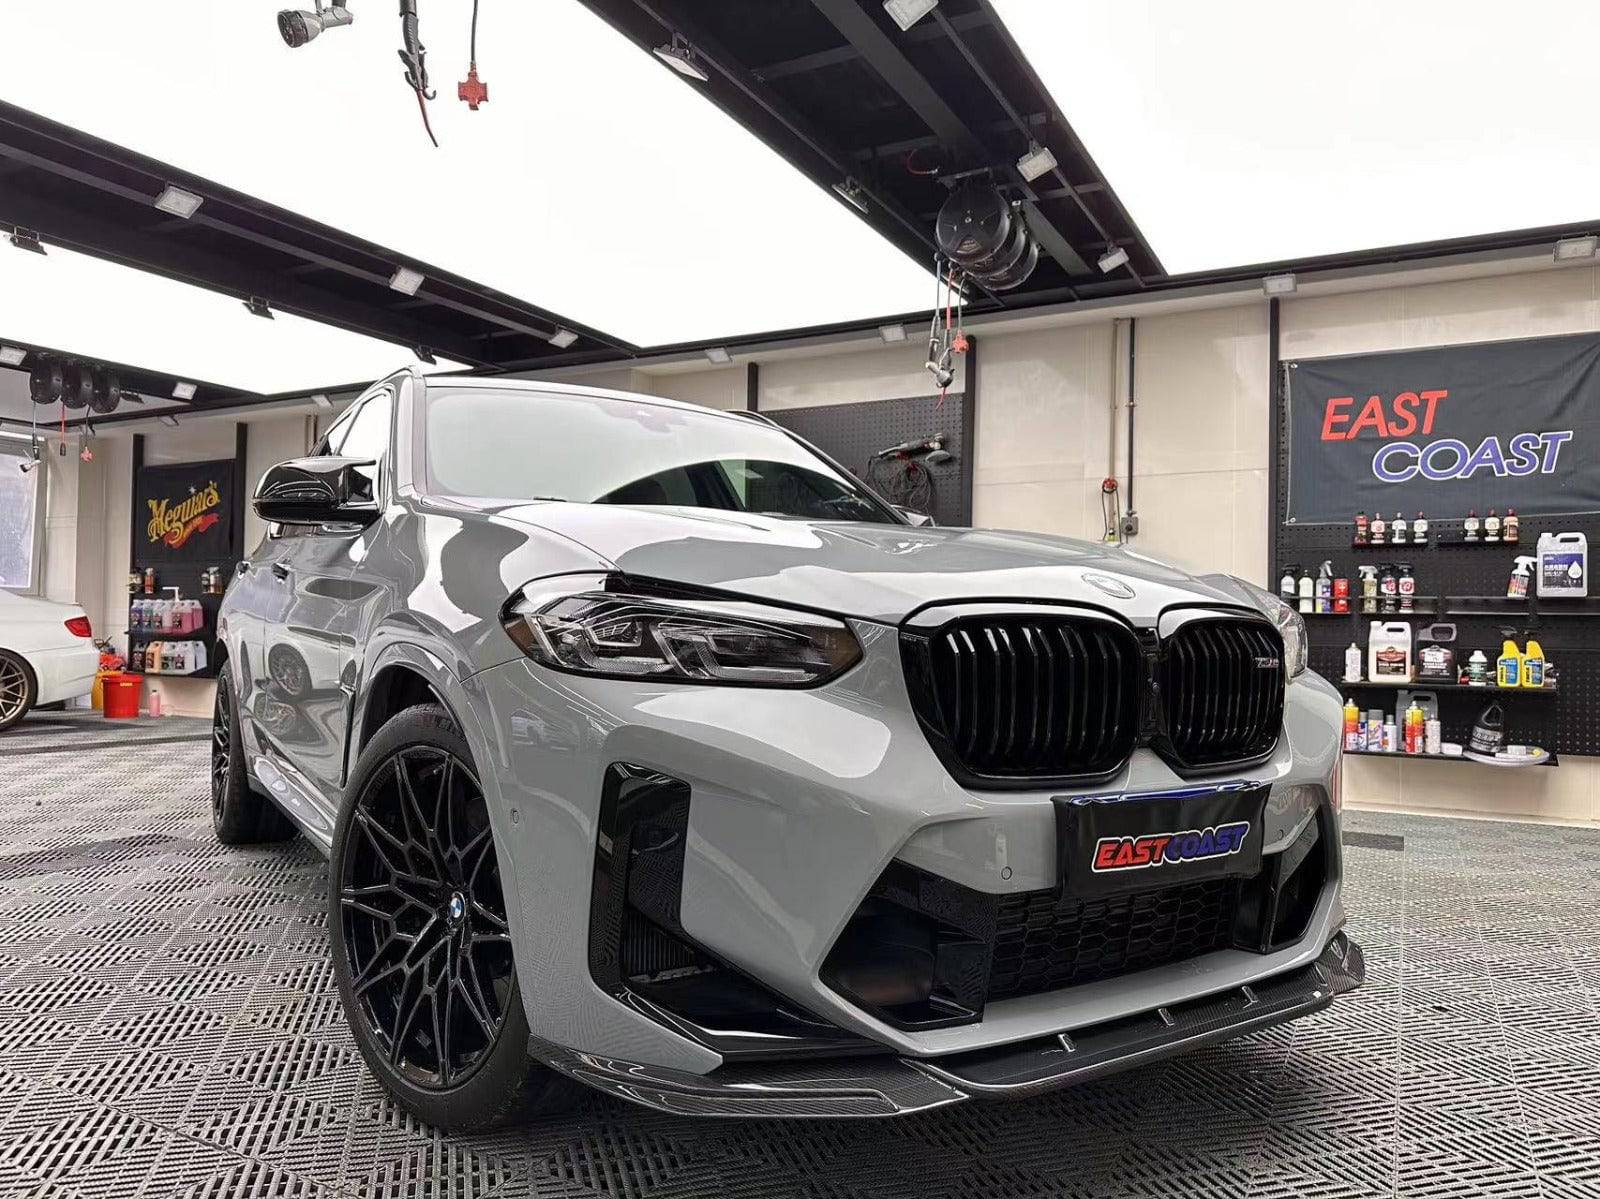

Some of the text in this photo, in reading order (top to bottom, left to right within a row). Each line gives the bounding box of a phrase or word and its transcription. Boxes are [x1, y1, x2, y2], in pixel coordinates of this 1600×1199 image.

[1321, 389, 1448, 441] EAST
[1372, 430, 1574, 483] COAST
[147, 480, 221, 544] Meguiar's
